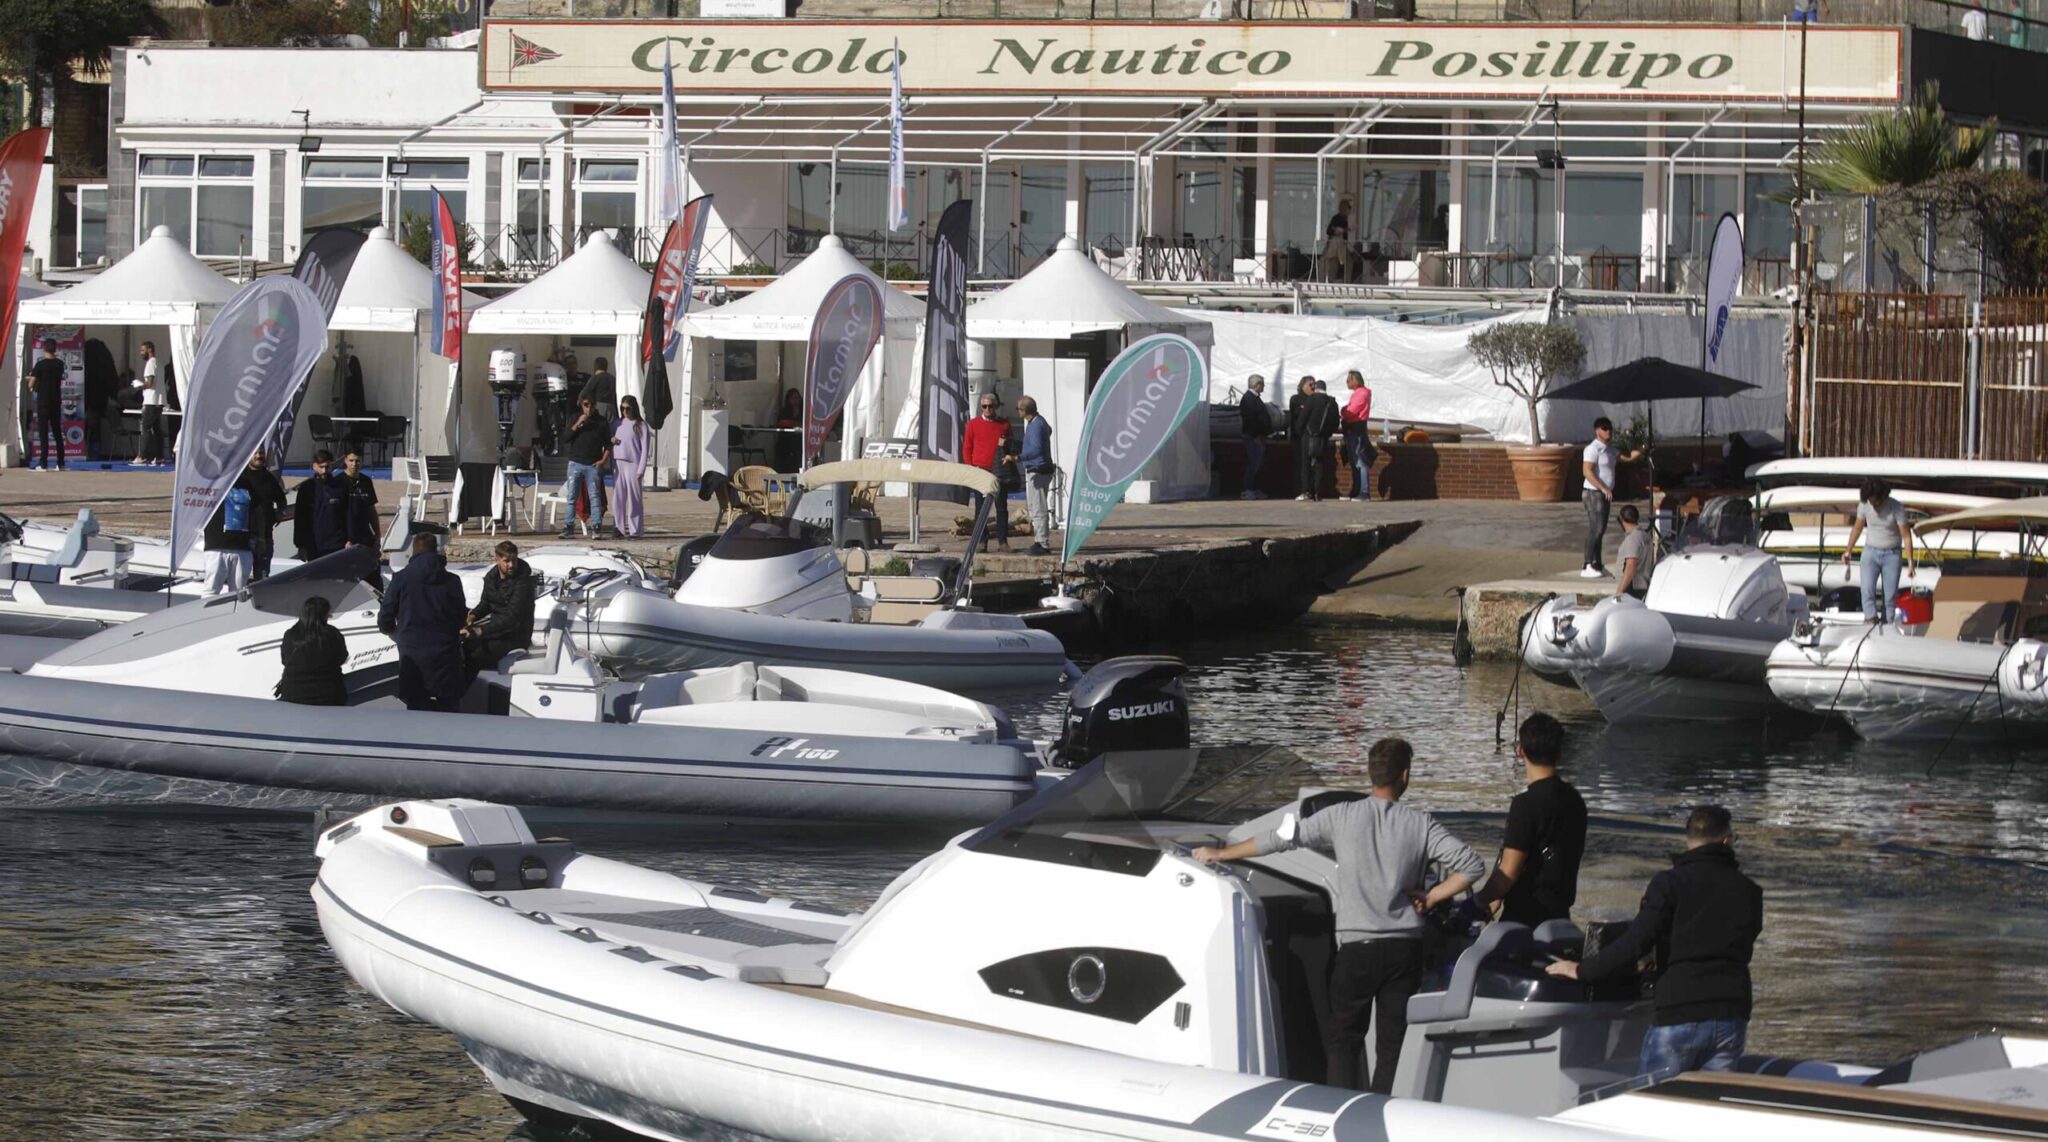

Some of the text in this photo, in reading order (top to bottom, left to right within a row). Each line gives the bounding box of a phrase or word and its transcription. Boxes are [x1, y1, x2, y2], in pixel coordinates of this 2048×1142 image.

[631, 36, 1733, 89] Circolo Nautico Posillipo
[684, 248, 699, 286] Marine
[184, 486, 219, 497] SPORT
[1080, 487, 1111, 502] Enjoy
[183, 498, 218, 508] CABIN
[1079, 502, 1102, 514] 10.0
[1108, 700, 1175, 720] SUZUKI
[795, 748, 840, 760] 100
[1266, 1117, 1330, 1137] C-38
